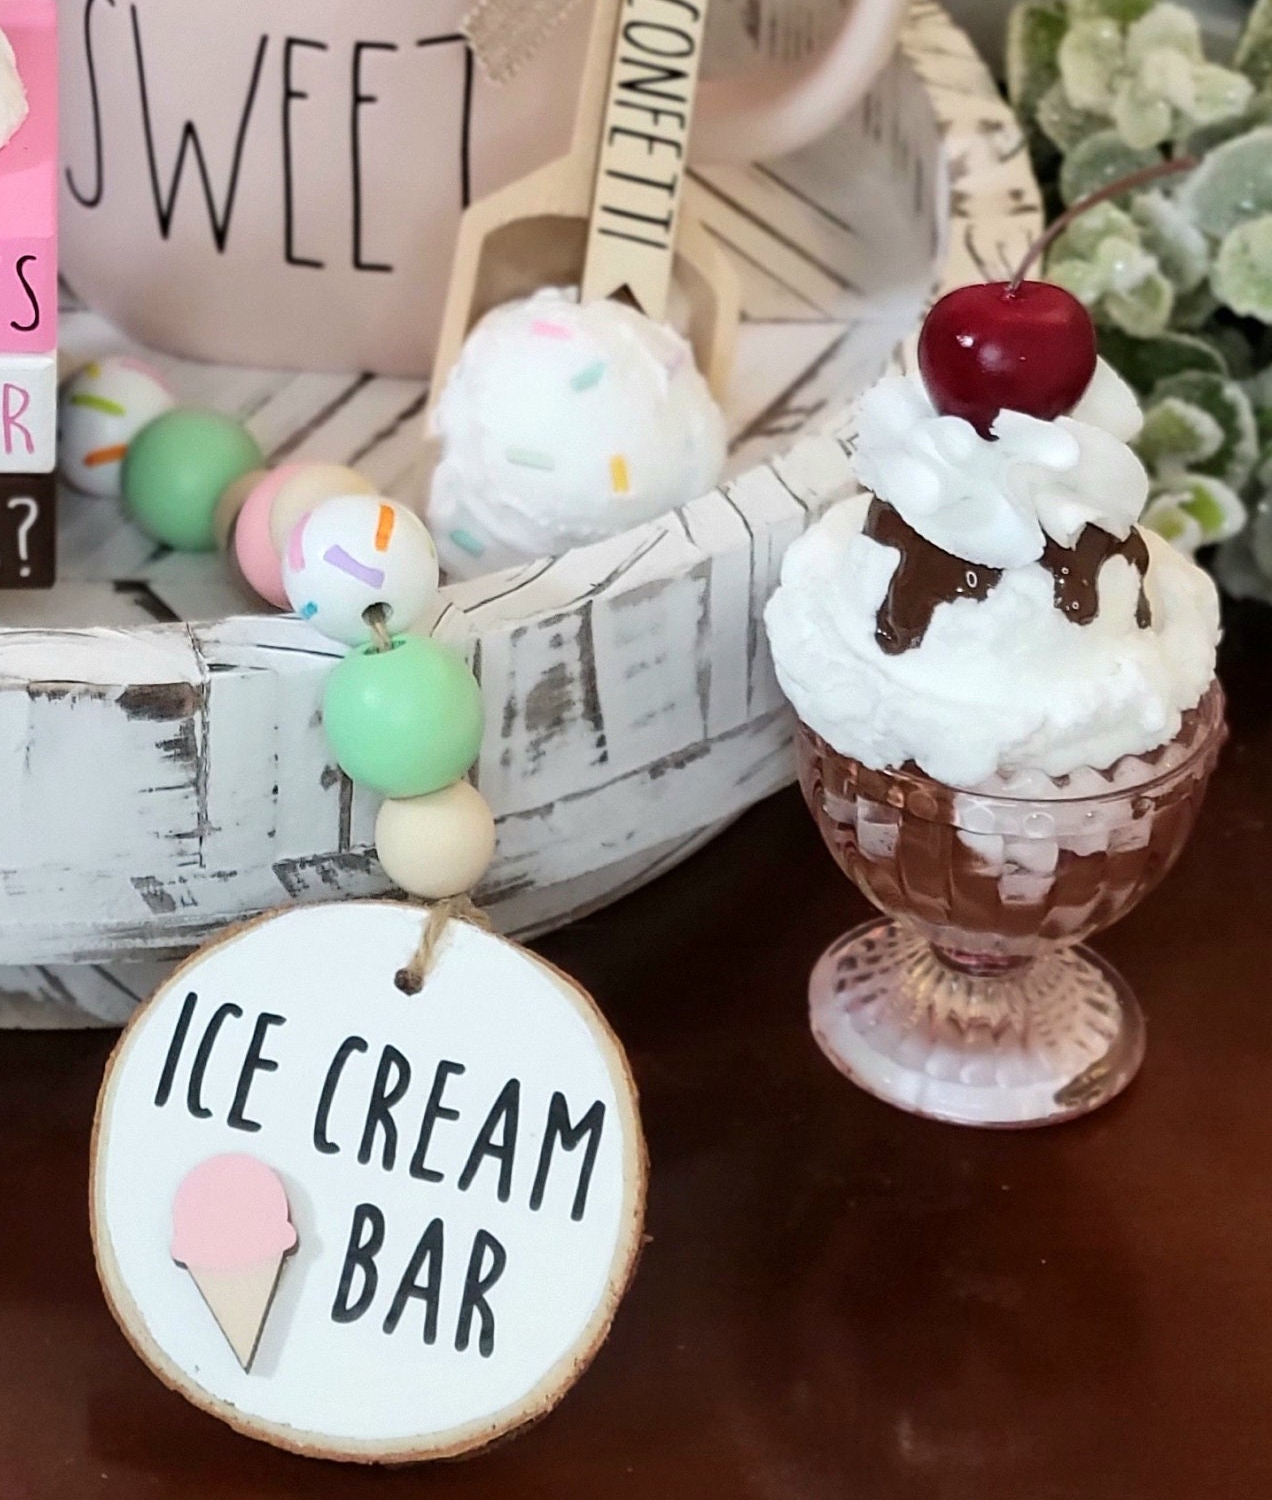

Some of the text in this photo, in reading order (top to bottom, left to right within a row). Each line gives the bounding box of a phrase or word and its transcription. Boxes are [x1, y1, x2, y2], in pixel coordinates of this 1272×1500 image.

[153, 991, 607, 1223] ICE CREAM
[330, 1202, 507, 1358] BAR
